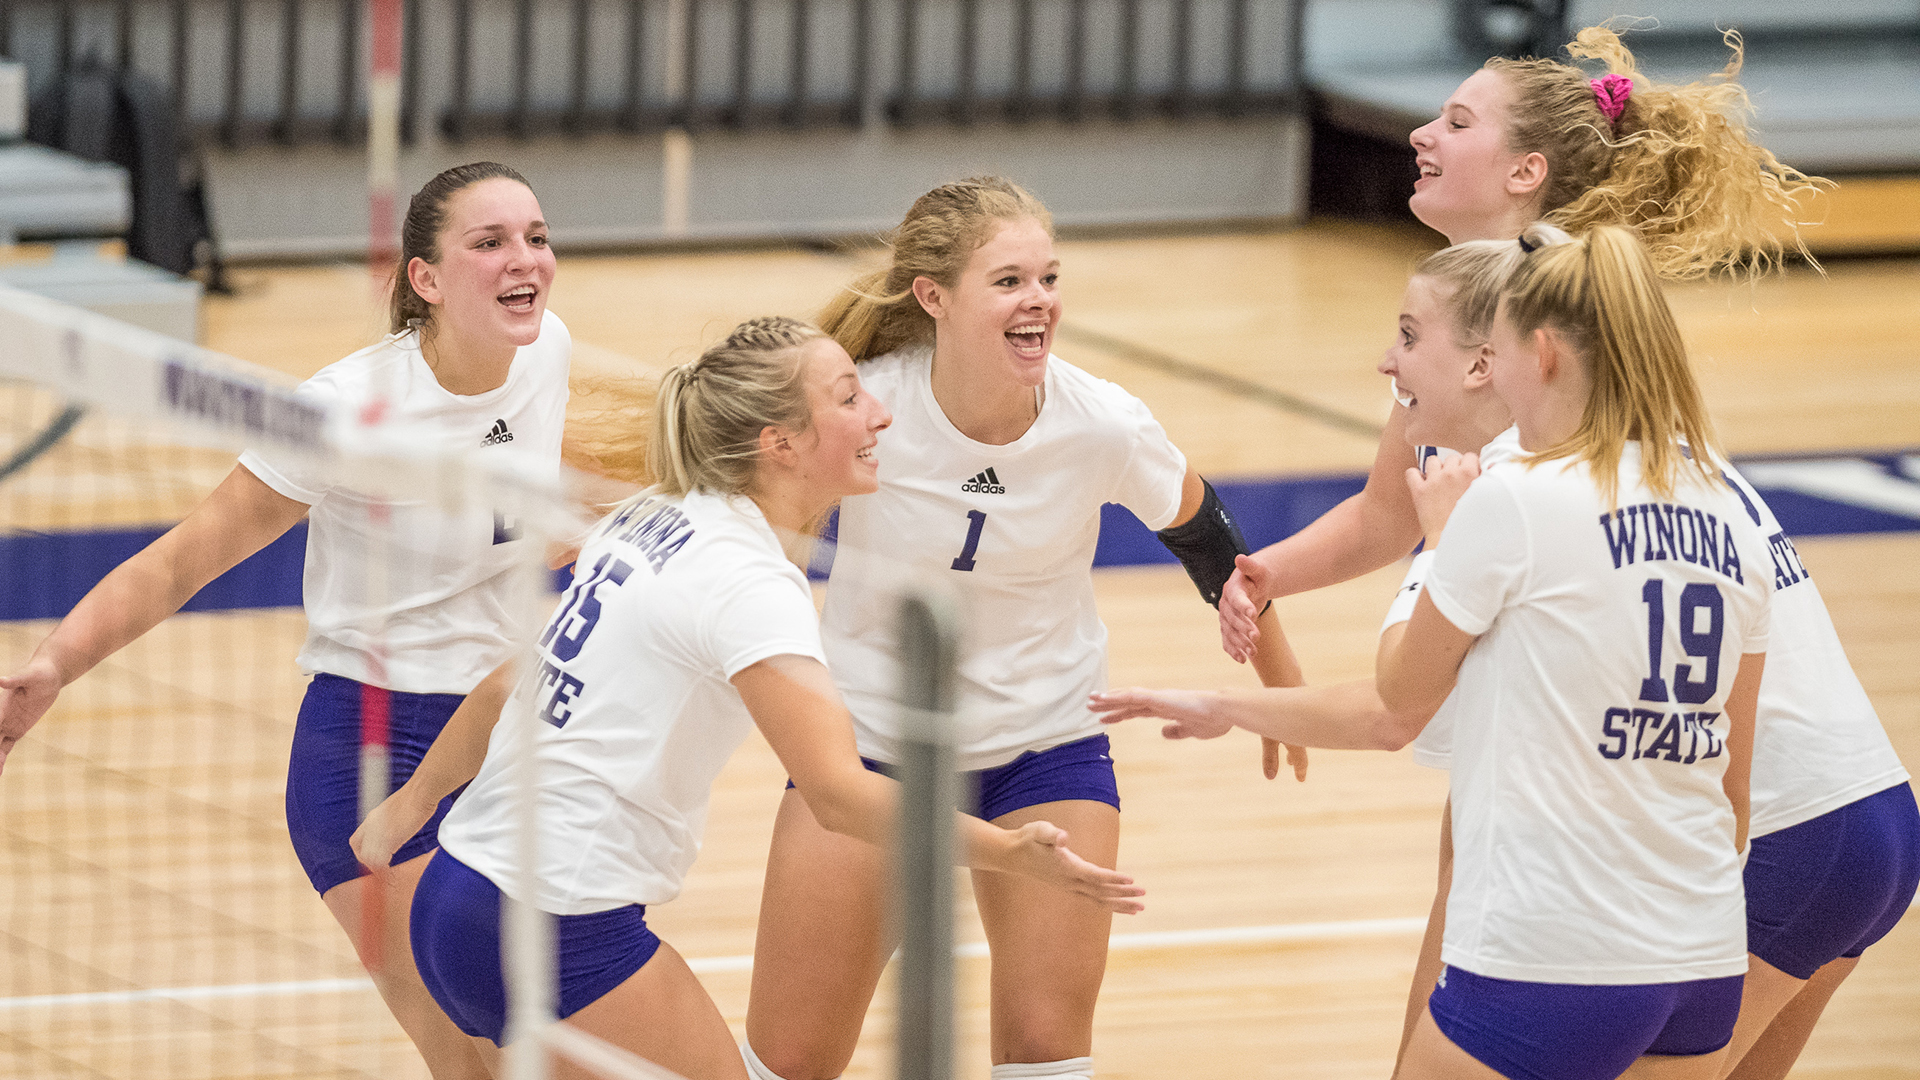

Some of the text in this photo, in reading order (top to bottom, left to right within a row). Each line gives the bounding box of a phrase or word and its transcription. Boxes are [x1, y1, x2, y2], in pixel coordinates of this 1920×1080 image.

[480, 432, 513, 448] adidas
[961, 482, 1005, 494] adidas
[950, 509, 987, 572] 1
[1598, 502, 1744, 586] WINONA
[539, 552, 634, 662] 15
[1639, 578, 1724, 704] 19
[1598, 706, 1723, 764] STATE
